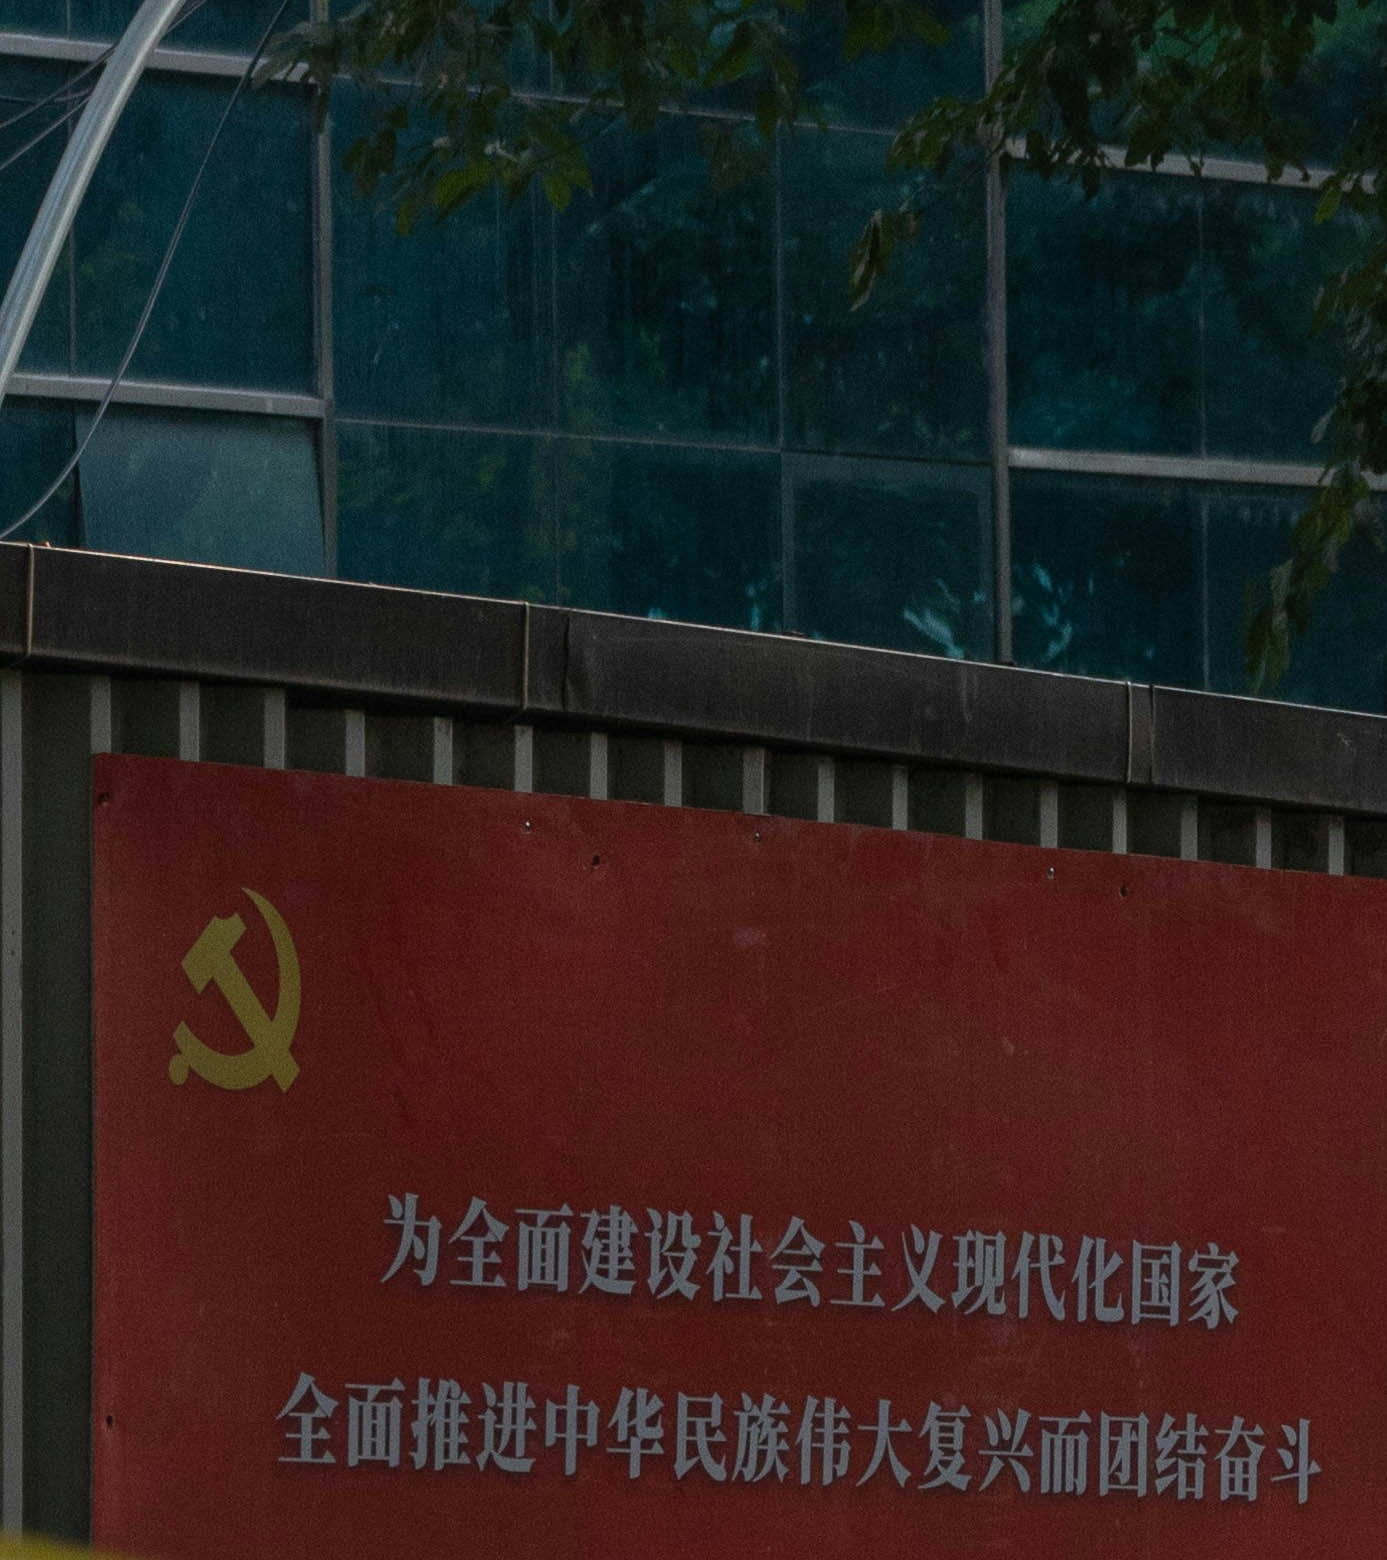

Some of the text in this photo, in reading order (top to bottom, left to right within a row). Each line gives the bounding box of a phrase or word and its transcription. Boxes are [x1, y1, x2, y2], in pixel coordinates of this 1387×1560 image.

[380, 1192, 1240, 1330] 为全面建设社会主义现代化国家
[275, 1372, 1322, 1507] 全面推进中华民族伟大复兴而团结奋斗
